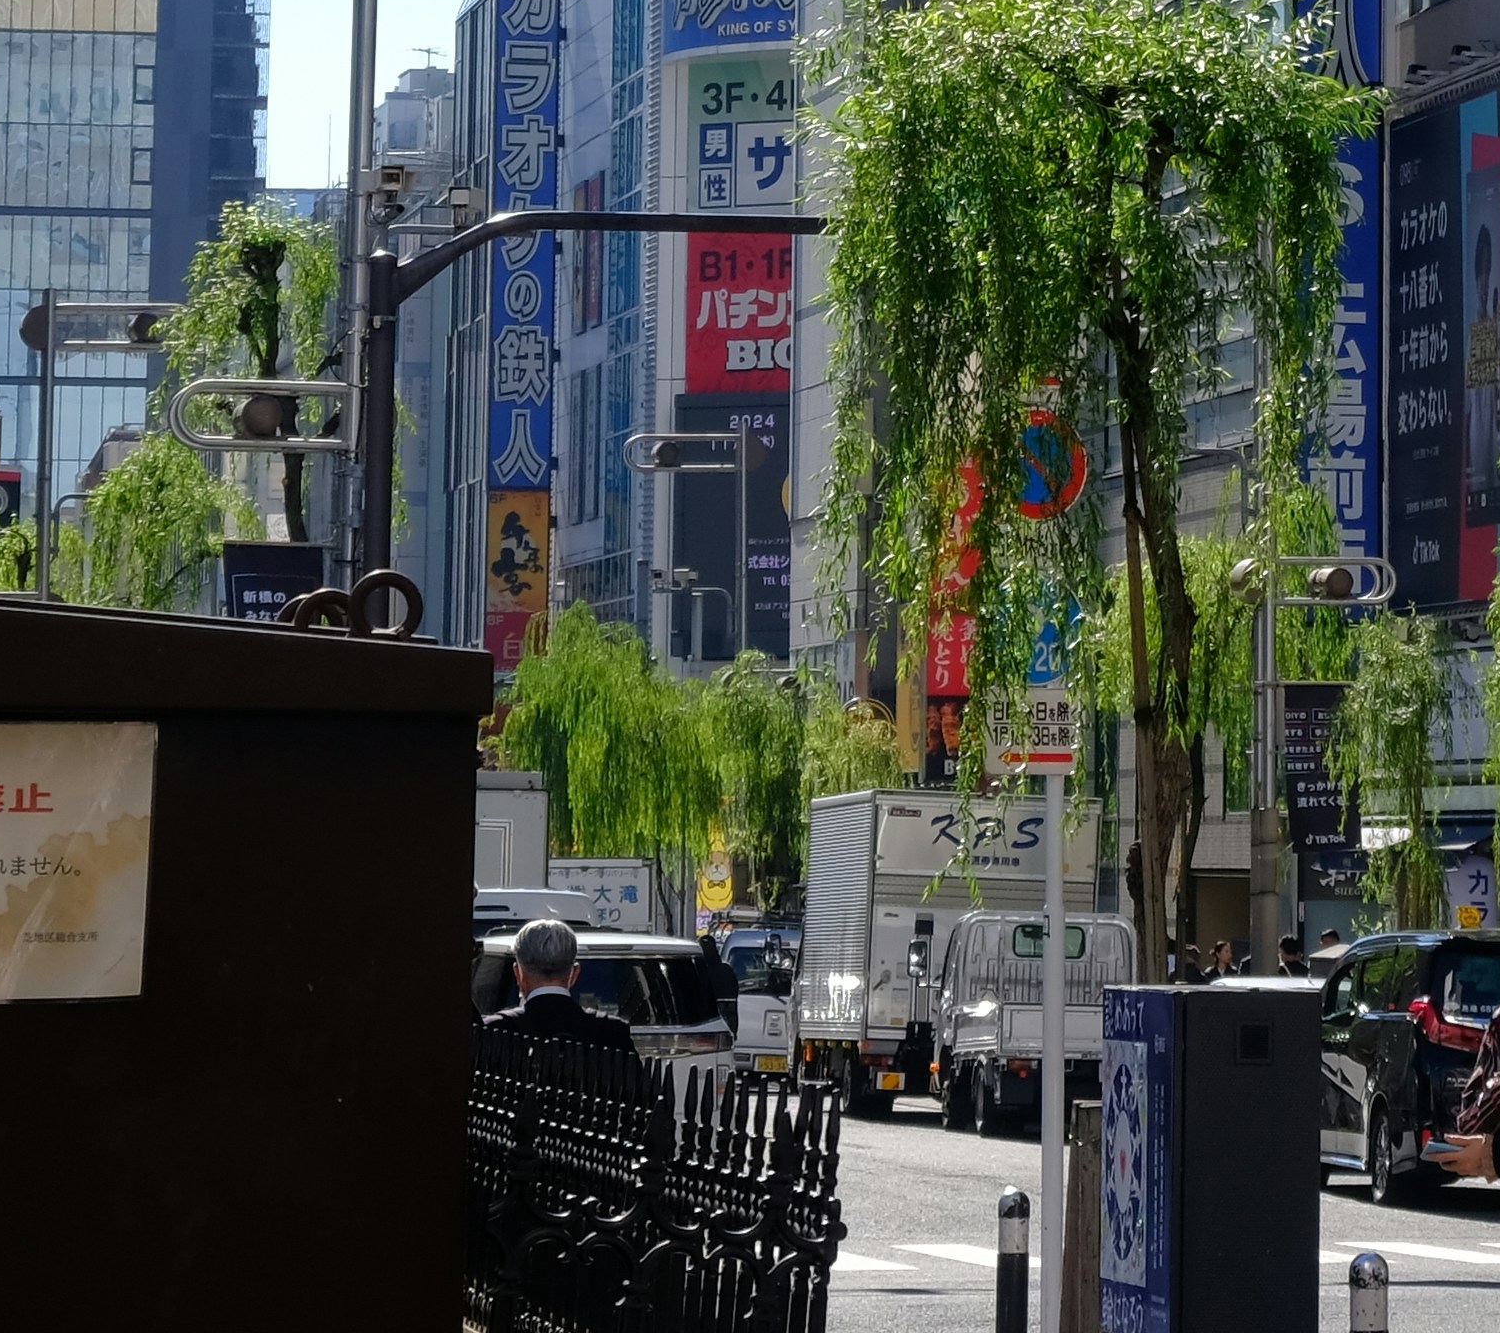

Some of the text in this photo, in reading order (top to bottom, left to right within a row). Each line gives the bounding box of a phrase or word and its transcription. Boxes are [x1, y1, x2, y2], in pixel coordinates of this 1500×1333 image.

[717, 23, 749, 37] KING
[753, 22, 773, 35] OF
[703, 128, 730, 205] 男性
[1399, 200, 1449, 252] カラオケの
[1398, 261, 1444, 315] 十八番が、
[1398, 321, 1449, 374] 十年前から
[1396, 385, 1454, 435] 変わらない。
[930, 813, 1046, 850] KPS
[593, 884, 639, 905] 大滝
